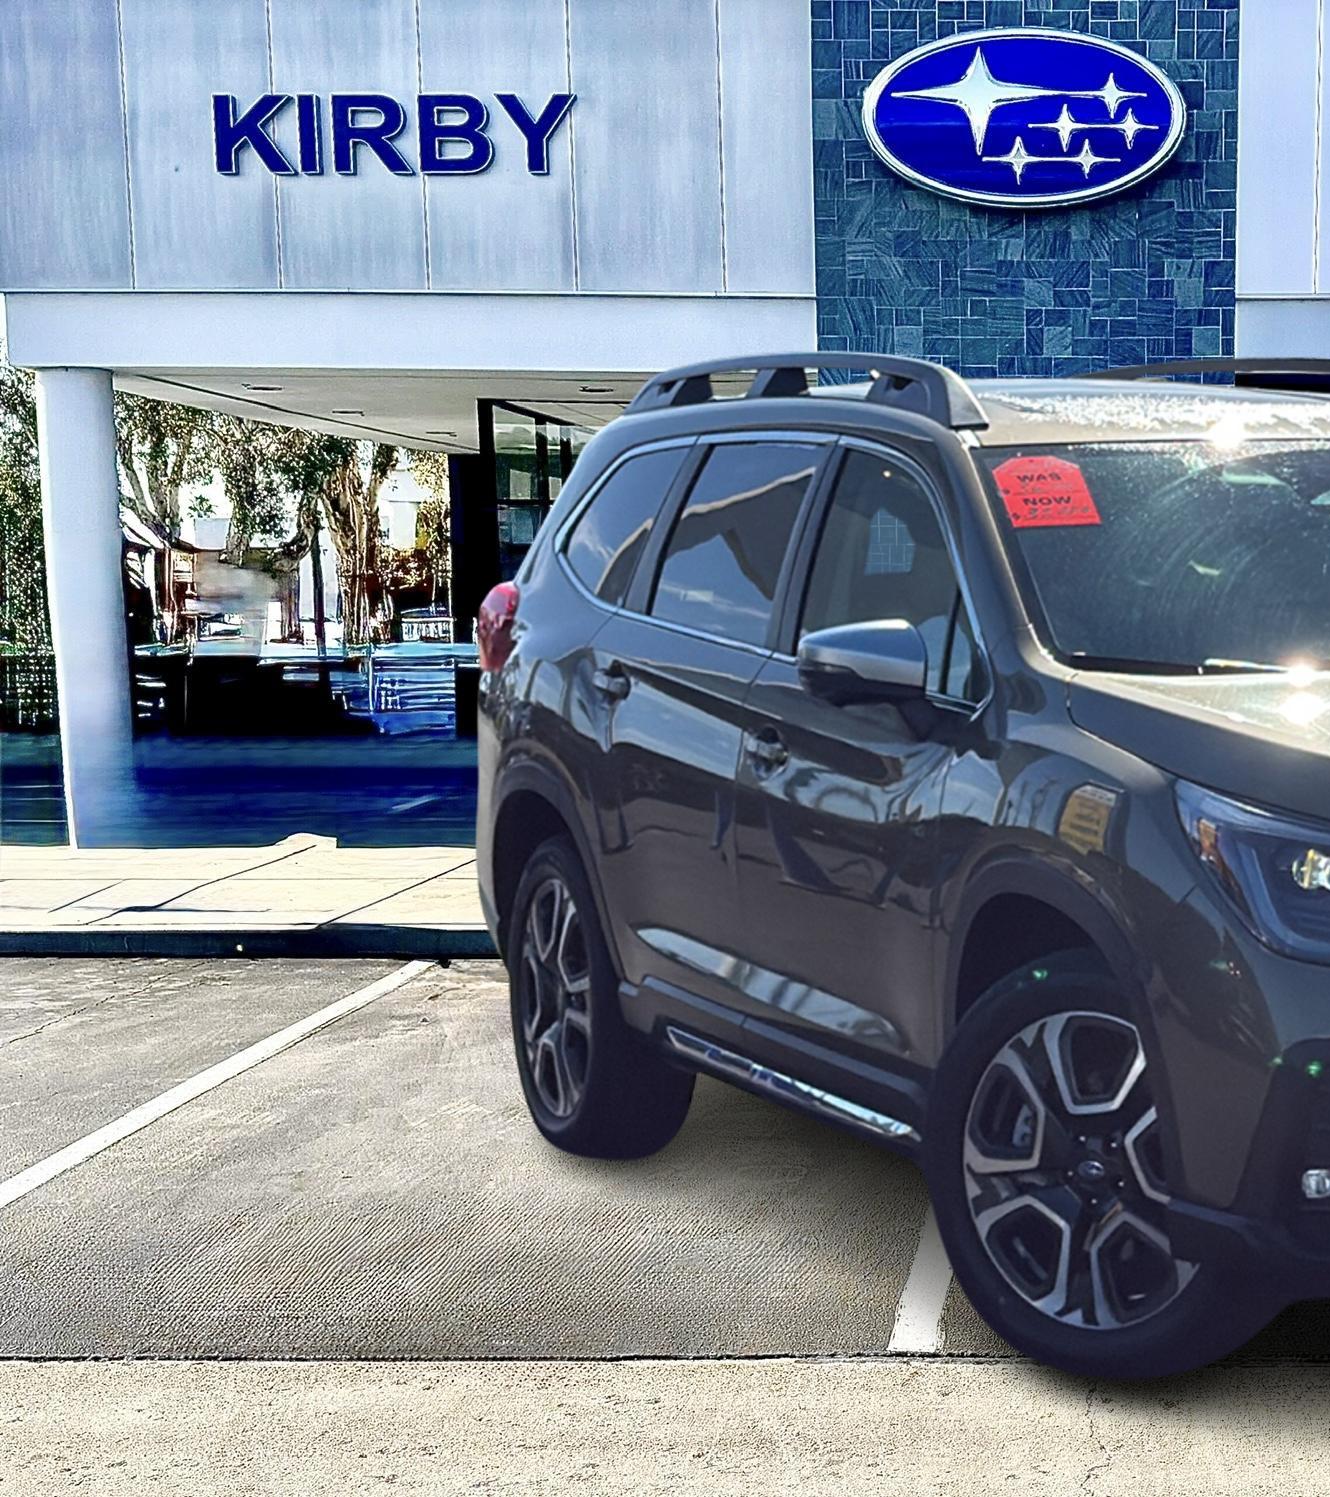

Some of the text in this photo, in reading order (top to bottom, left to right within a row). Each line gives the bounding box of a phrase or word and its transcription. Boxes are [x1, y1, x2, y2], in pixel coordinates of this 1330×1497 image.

[211, 93, 577, 175] KIRBY
[1017, 472, 1062, 482] WAS
[1023, 496, 1072, 506] NOW
